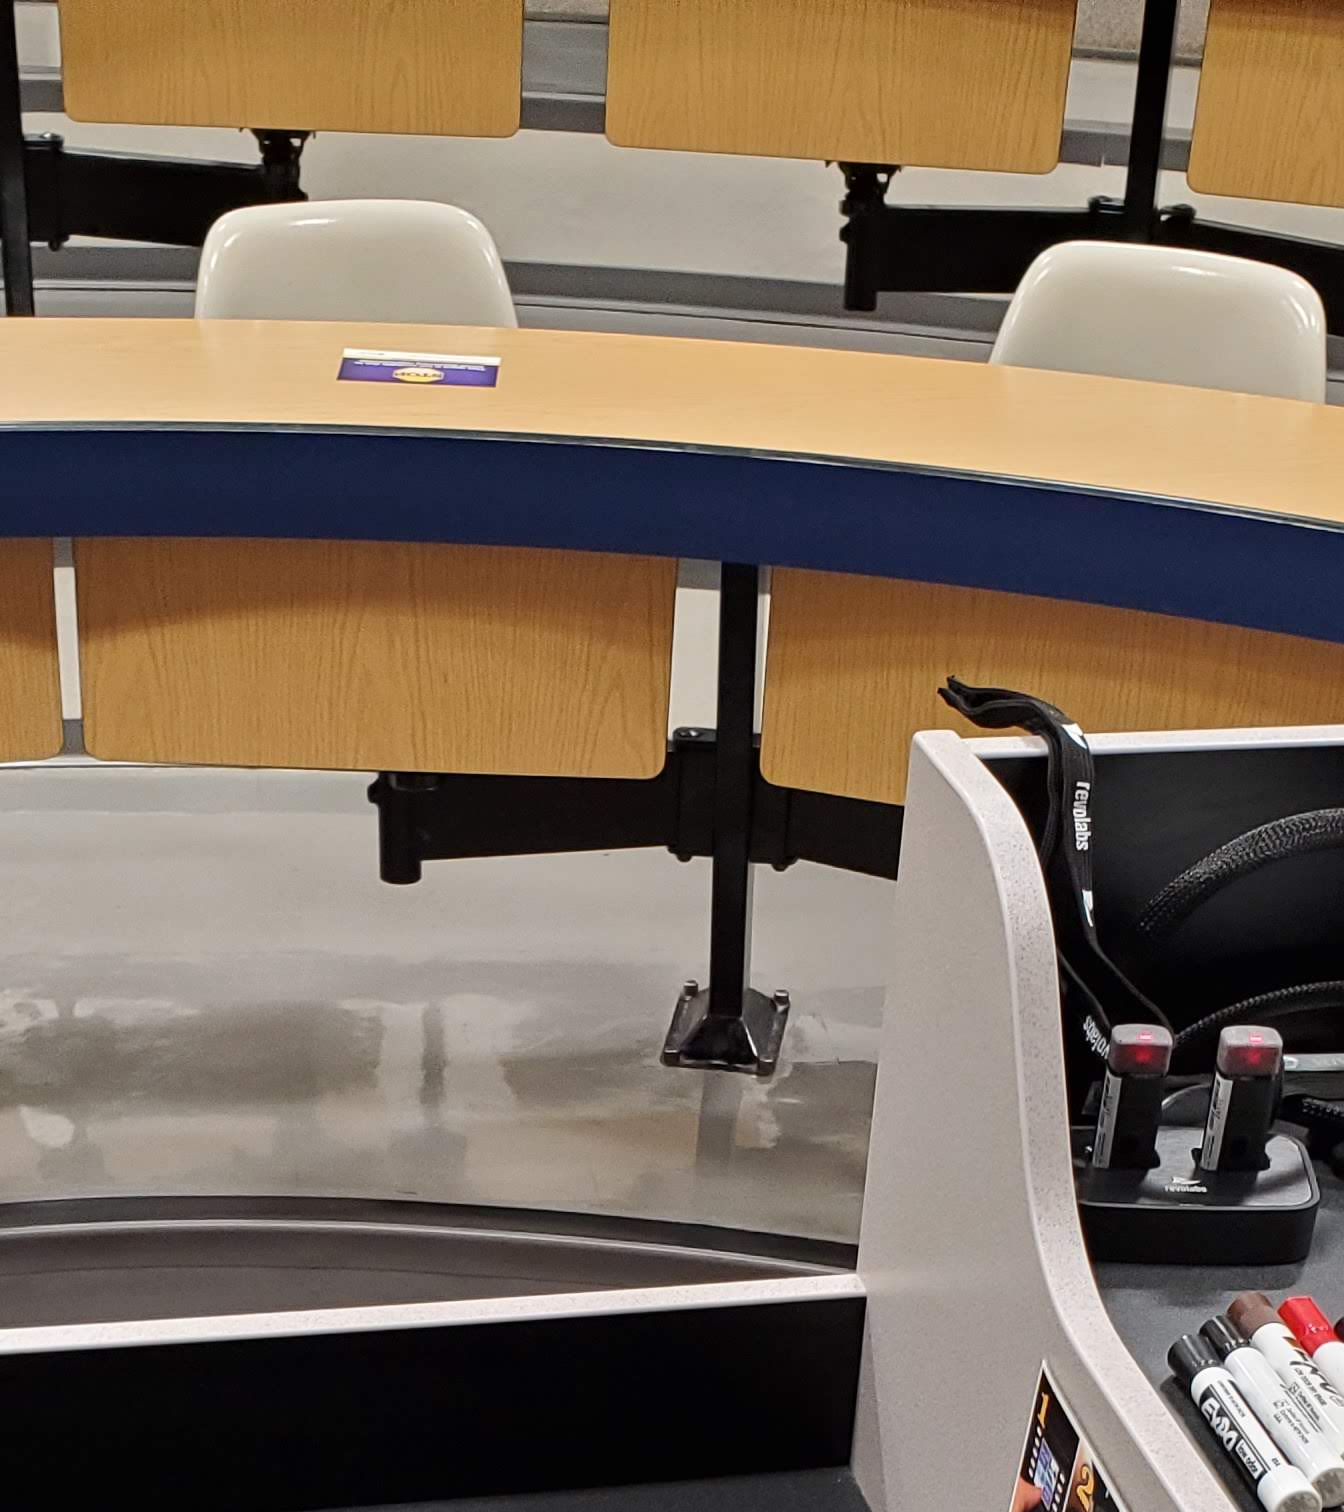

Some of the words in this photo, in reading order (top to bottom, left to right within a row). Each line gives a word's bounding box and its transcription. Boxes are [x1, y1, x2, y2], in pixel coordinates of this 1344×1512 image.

[1072, 781, 1091, 851] revolabs
[1083, 1015, 1110, 1060] volabs
[1036, 1392, 1049, 1430] 1
